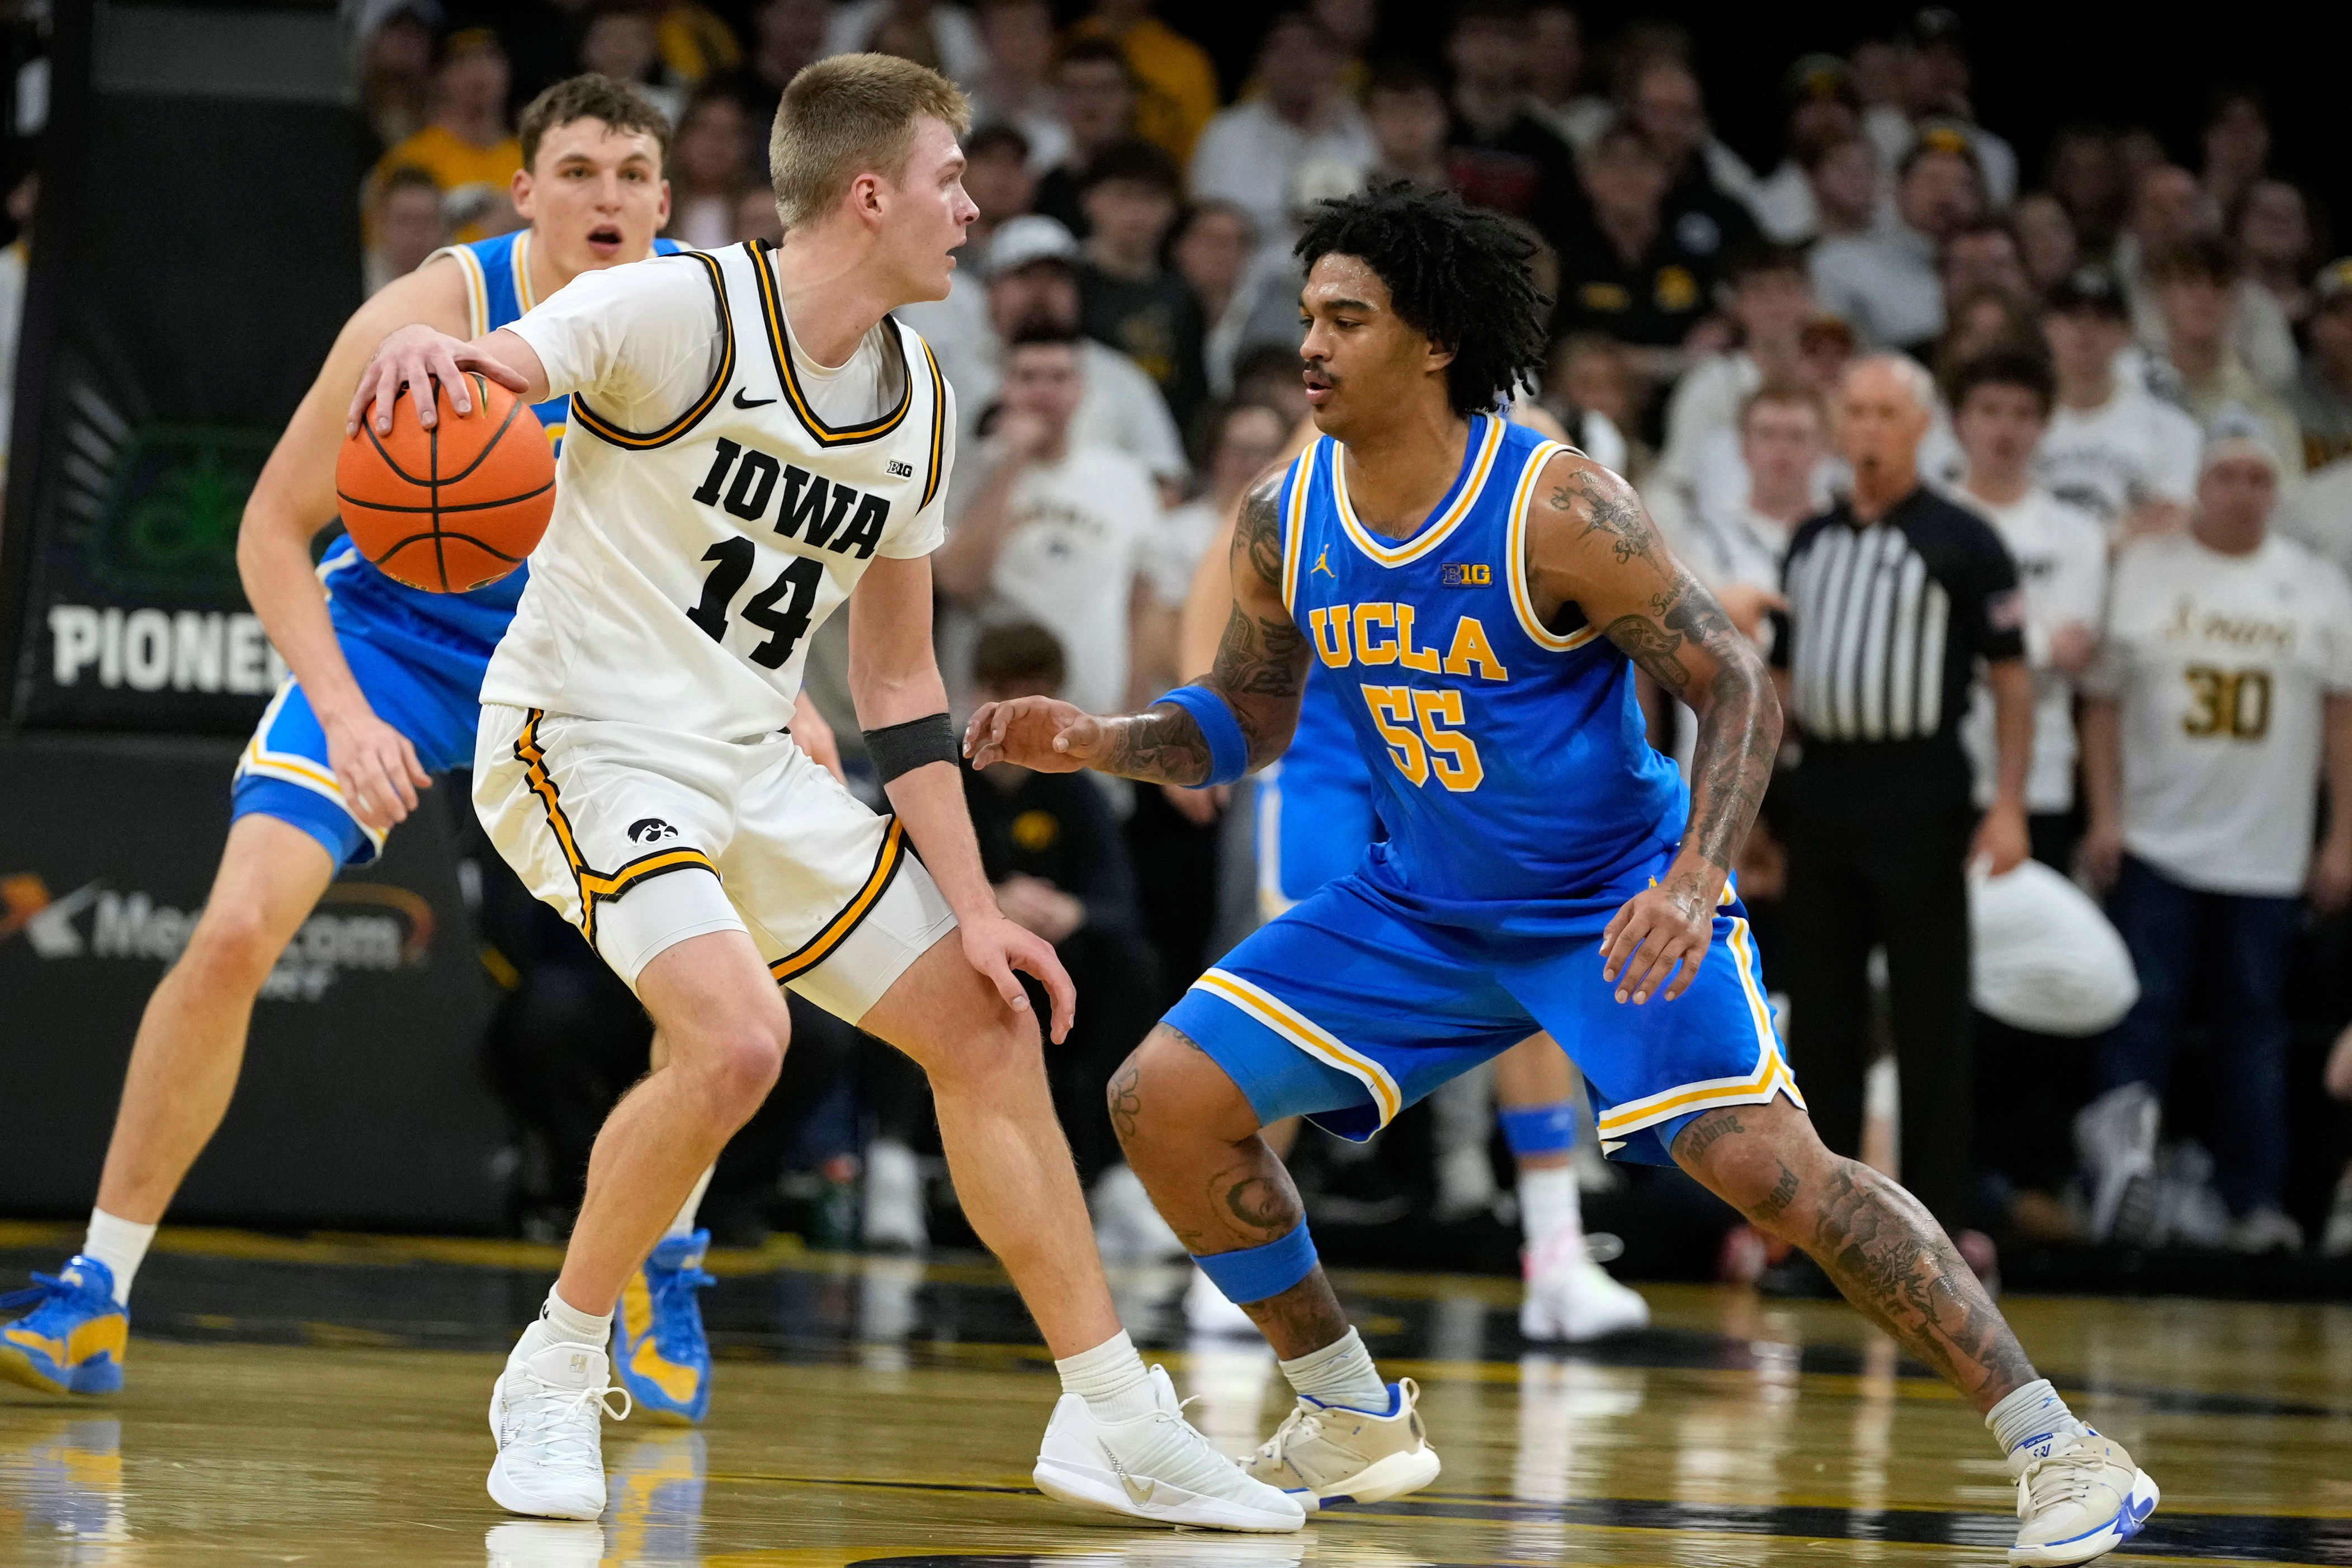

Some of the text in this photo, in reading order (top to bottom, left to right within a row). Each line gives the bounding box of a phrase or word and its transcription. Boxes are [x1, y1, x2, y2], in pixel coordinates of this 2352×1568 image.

[692, 437, 890, 559] IOWA
[686, 536, 823, 669] 14
[1309, 602, 1508, 681] UCLA
[1360, 683, 1484, 792] 55
[2184, 664, 2274, 742] 30
